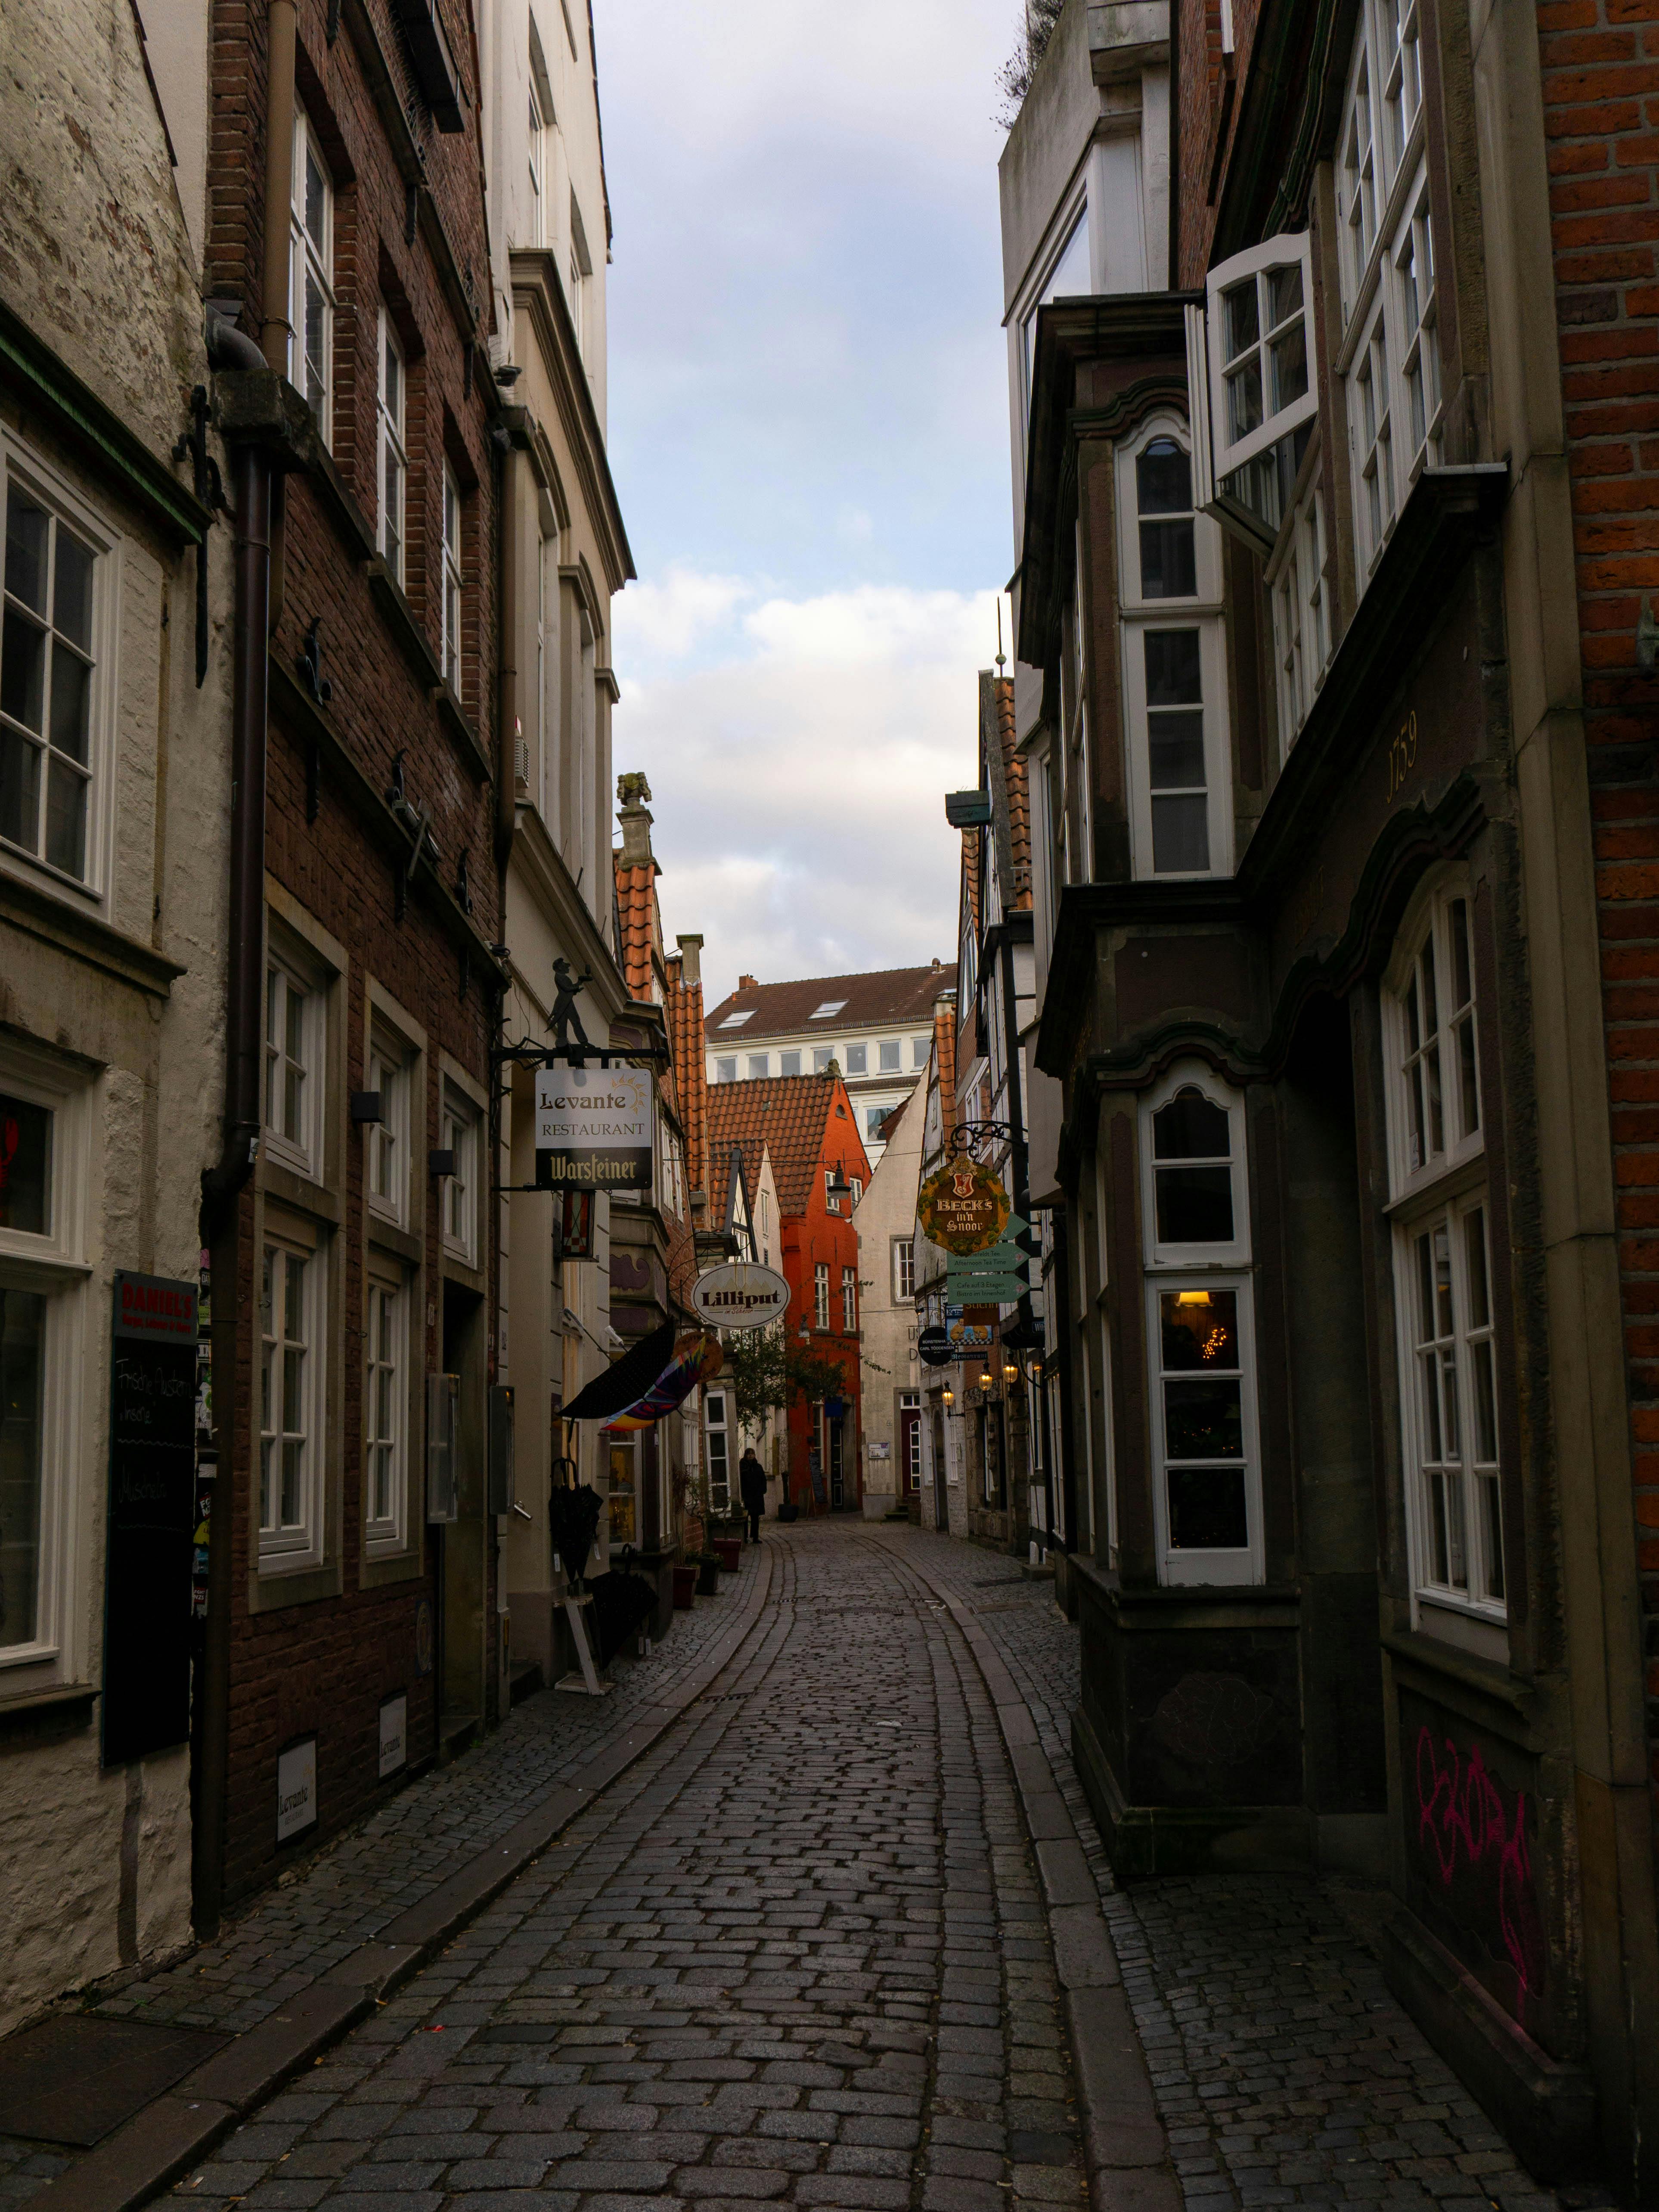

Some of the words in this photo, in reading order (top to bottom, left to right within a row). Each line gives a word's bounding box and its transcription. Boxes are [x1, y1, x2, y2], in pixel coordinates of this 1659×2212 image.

[1386, 709, 1418, 805] 1759
[540, 1093, 626, 1110] Levante
[542, 1123, 644, 1135] RESTAURANT
[550, 1153, 636, 1183] Warsteiner
[947, 1220, 983, 1232] Snoor
[122, 1283, 192, 1319] DANIEL'S
[701, 1290, 781, 1309] Lilliput
[380, 1735, 400, 1758] Levante
[279, 1786, 308, 1816] Levante
